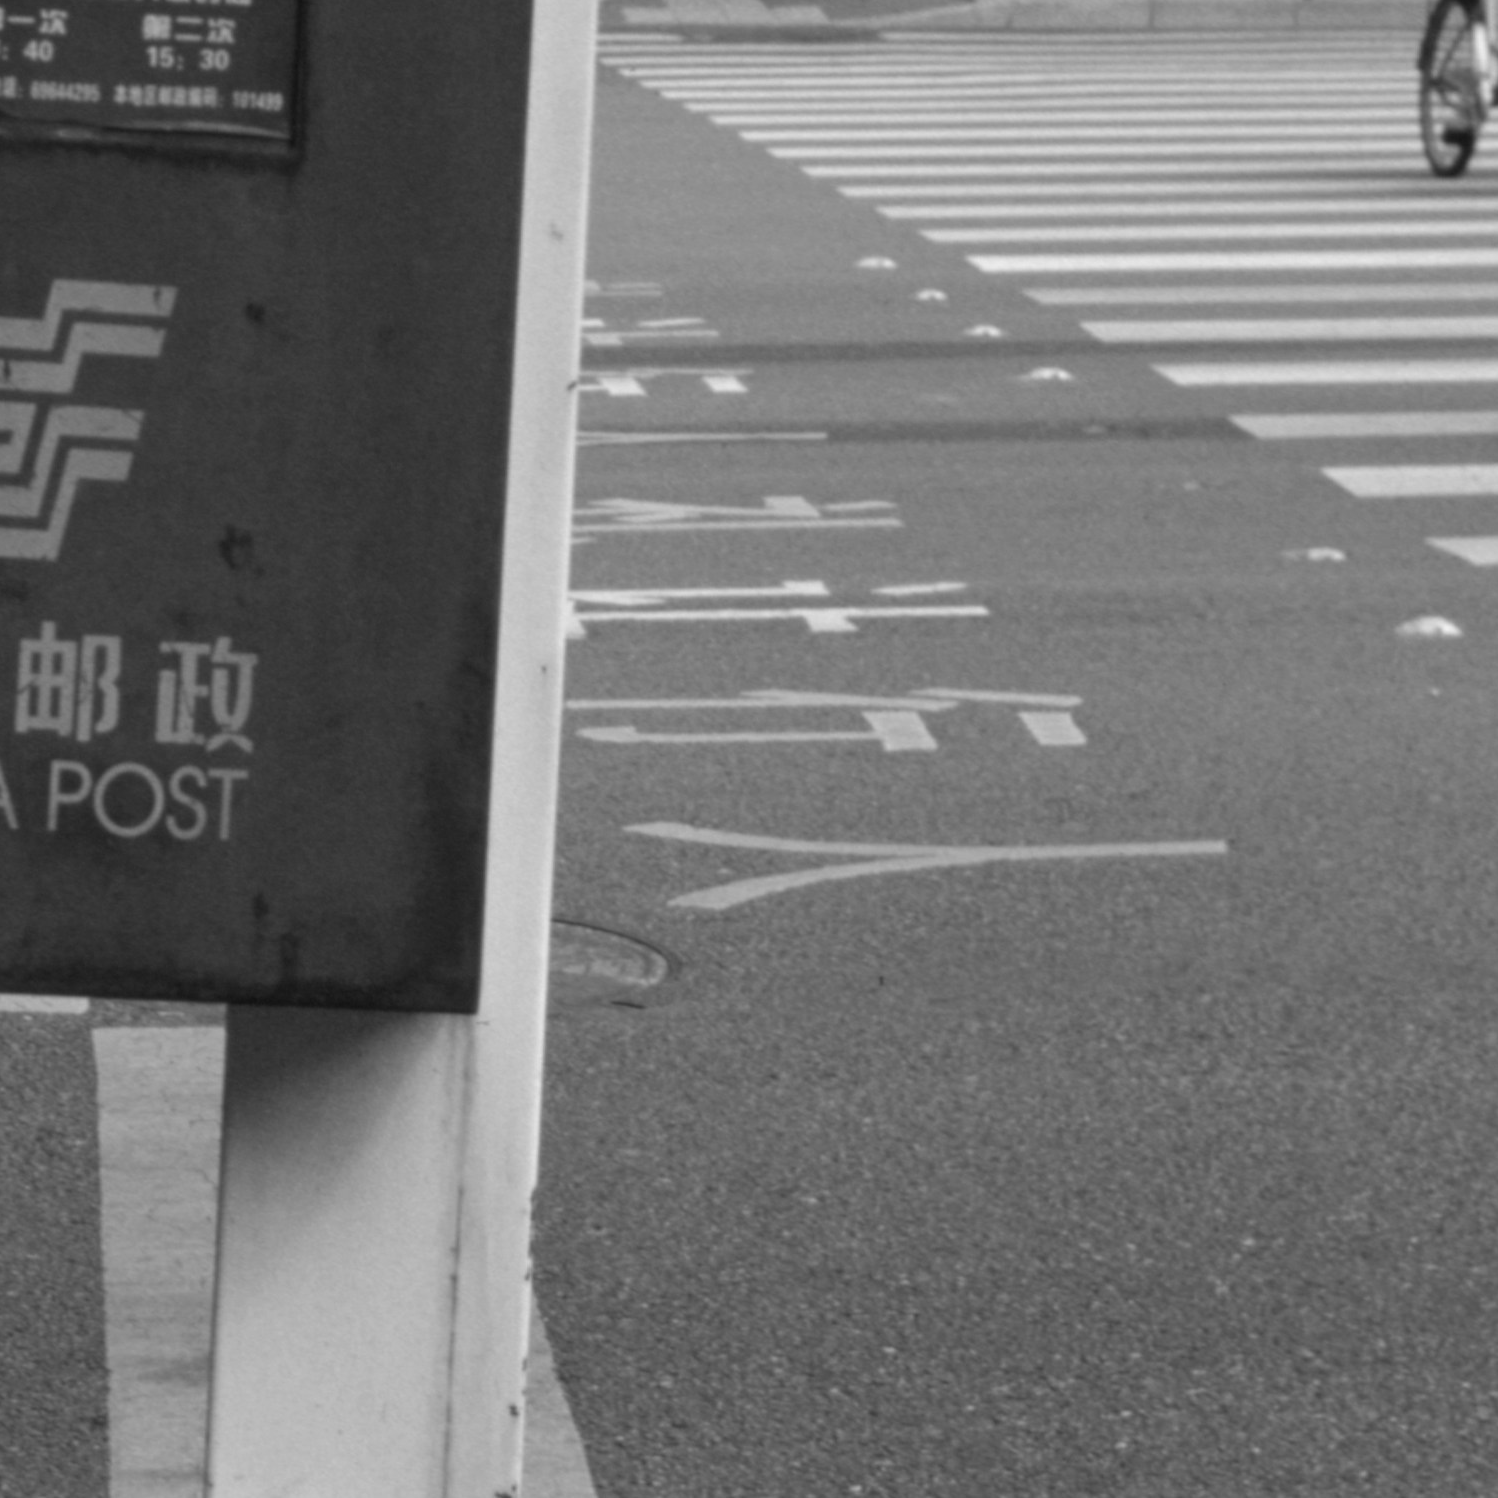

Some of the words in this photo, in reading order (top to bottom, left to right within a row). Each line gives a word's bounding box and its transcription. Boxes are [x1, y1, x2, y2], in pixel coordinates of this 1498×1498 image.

[142, 14, 236, 45] 第二次
[46, 759, 249, 841] POST
